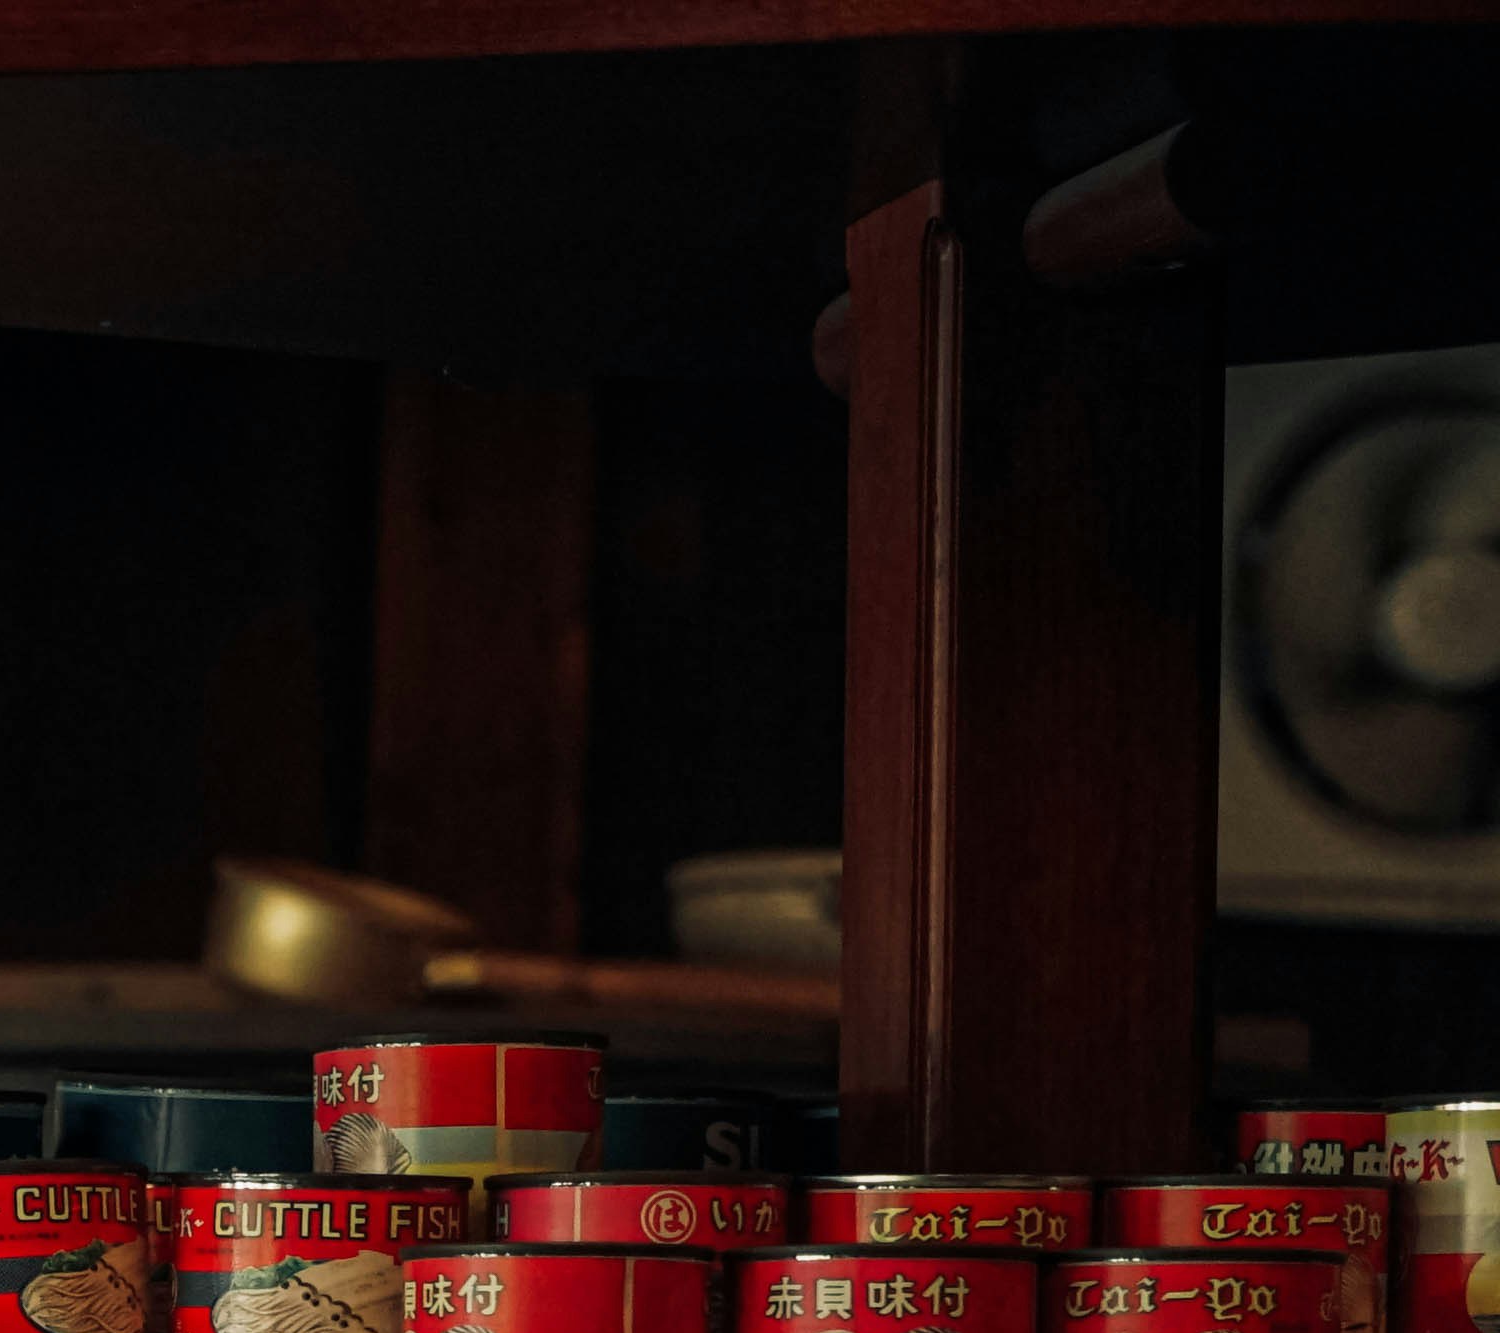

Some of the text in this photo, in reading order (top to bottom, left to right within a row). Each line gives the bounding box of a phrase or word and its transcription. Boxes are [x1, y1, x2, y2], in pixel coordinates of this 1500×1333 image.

[15, 1185, 140, 1226] CUTTLE
[214, 1202, 463, 1241] CUTTLE FISH
[711, 1200, 779, 1234] いか
[766, 1276, 971, 1321] 赤貝味付
